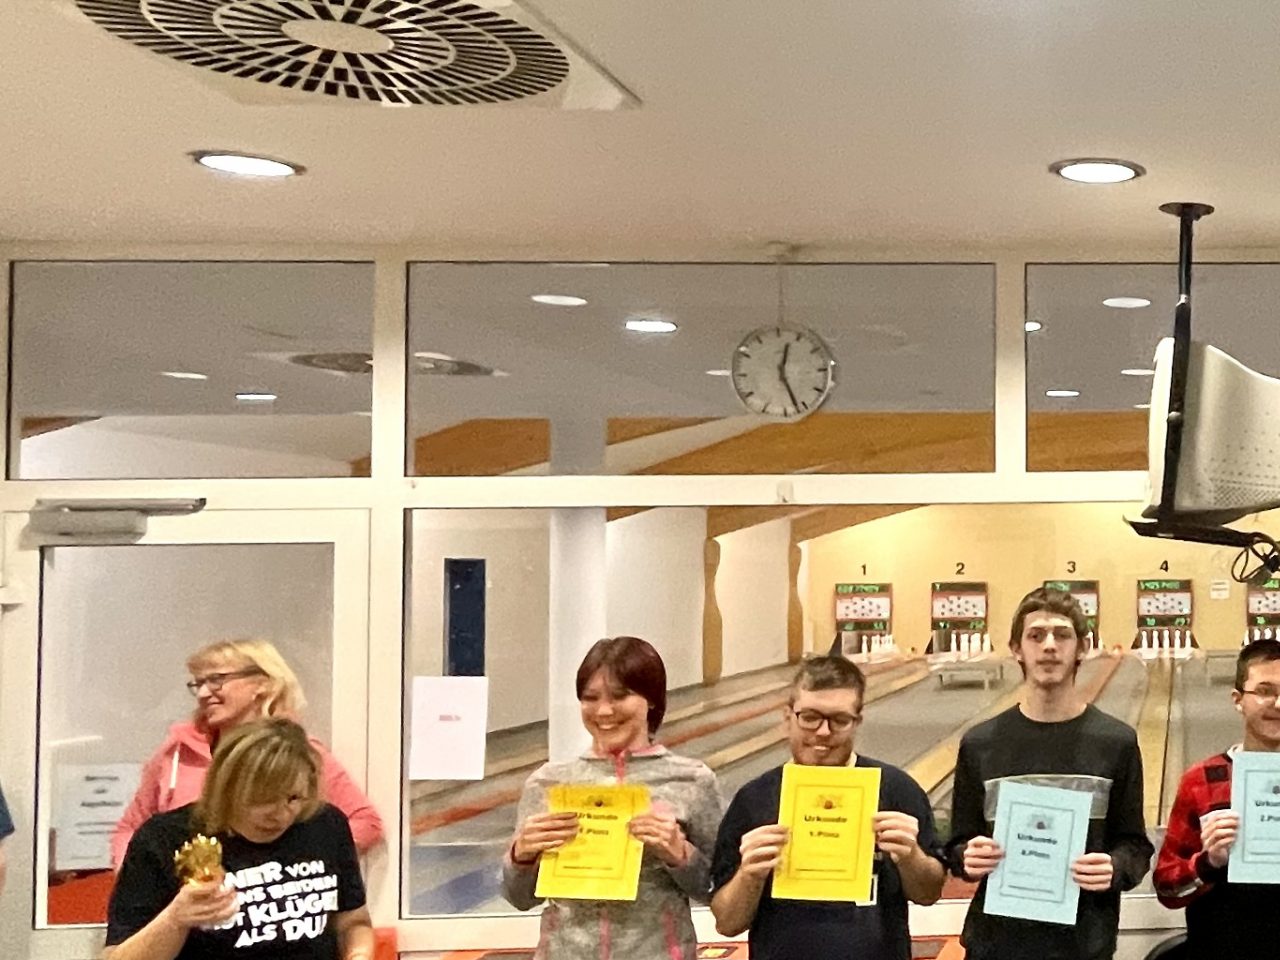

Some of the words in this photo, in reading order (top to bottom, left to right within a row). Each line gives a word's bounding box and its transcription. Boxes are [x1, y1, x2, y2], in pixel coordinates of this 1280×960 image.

[860, 563, 867, 576] 1
[955, 562, 965, 575] 2
[1066, 561, 1077, 573] 3
[1159, 560, 1169, 572] 4
[285, 860, 325, 878] VON
[236, 887, 266, 906] NS
[267, 874, 338, 899] BEIDEN
[234, 924, 277, 948] ALS
